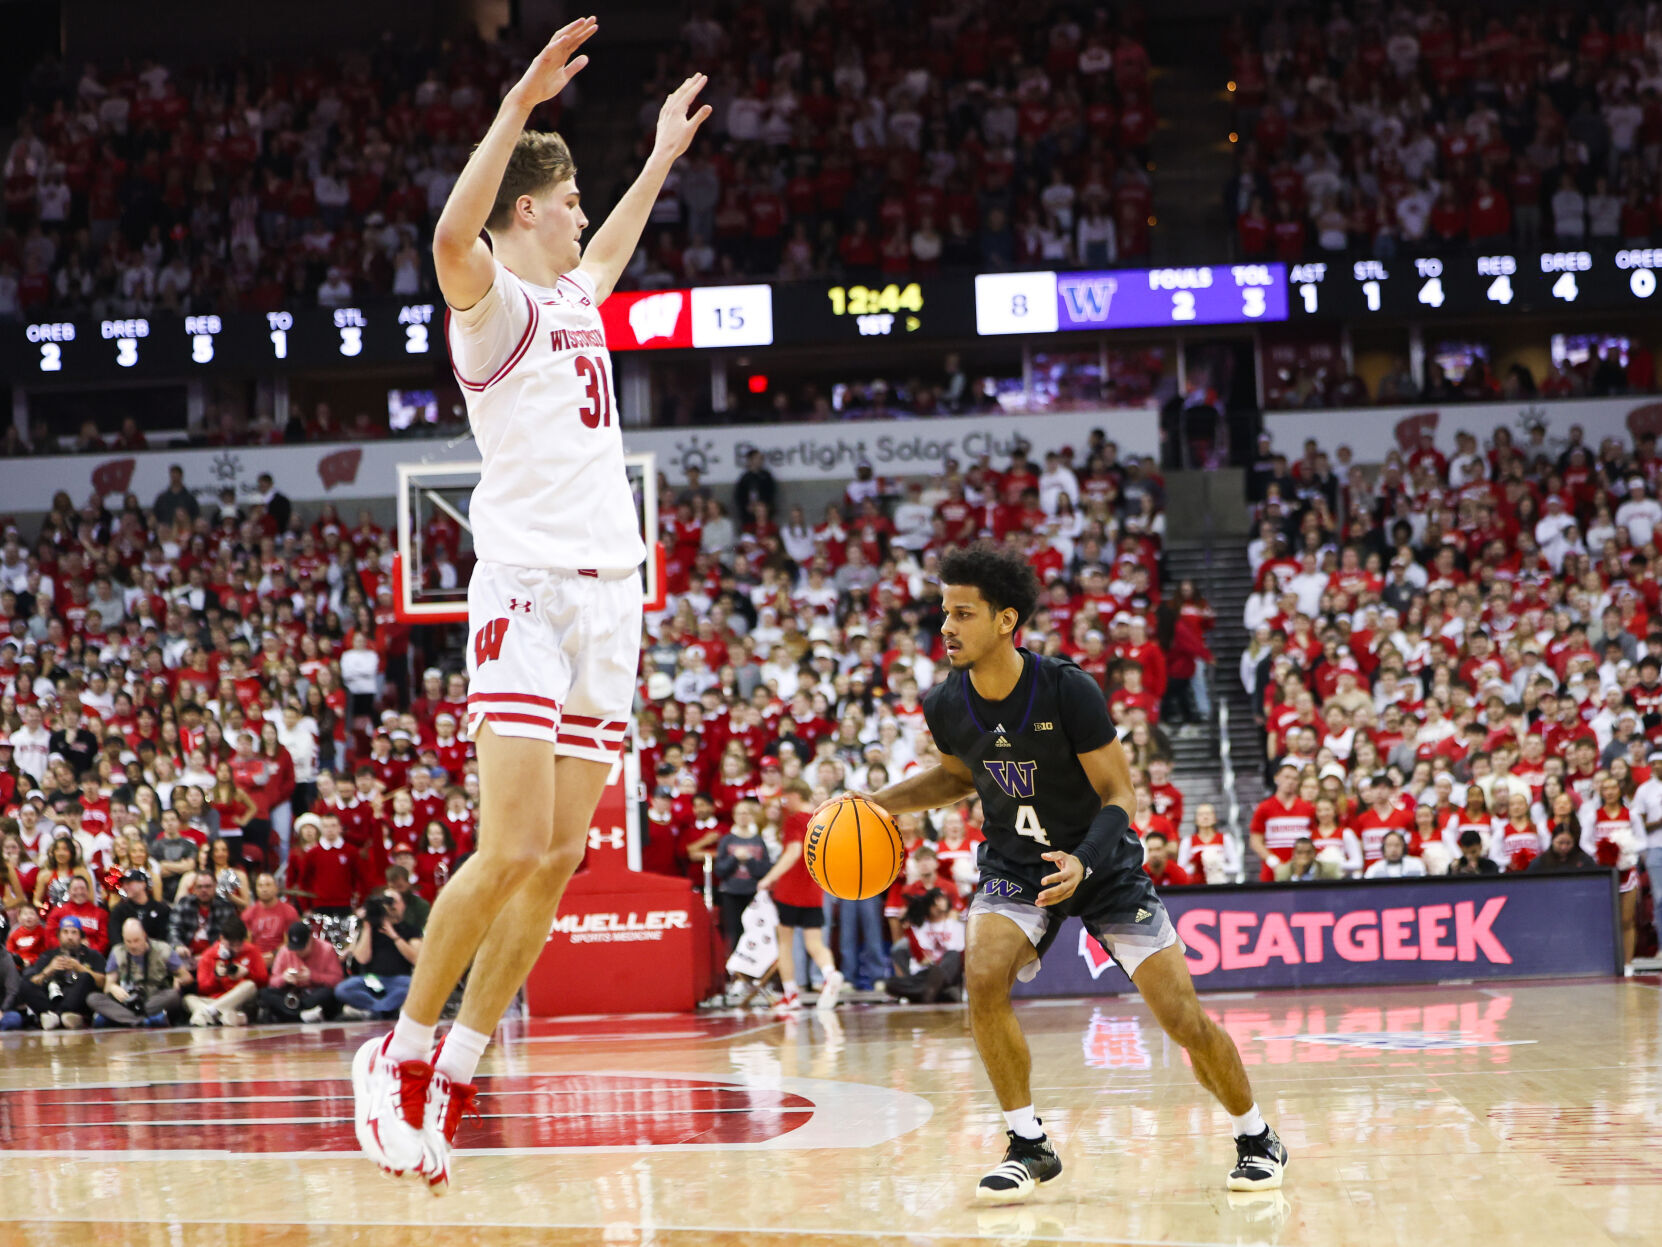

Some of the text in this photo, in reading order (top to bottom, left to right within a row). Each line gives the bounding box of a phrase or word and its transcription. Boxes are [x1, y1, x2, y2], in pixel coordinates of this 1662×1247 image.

[1231, 264, 1274, 286] TOL
[1290, 263, 1327, 283] AST
[1353, 261, 1389, 280] STL
[1414, 258, 1443, 278] TO
[1477, 256, 1517, 275] REB
[1541, 252, 1592, 272] DREB
[1149, 267, 1213, 290] FOULS
[1418, 277, 1445, 307] 4
[1487, 275, 1514, 304] 4
[1552, 272, 1579, 302] 4
[1630, 269, 1657, 298] 0
[828, 283, 924, 316] 12:44
[1011, 295, 1028, 317] 8
[1058, 277, 1118, 322] W
[1171, 290, 1196, 320] 2
[1241, 287, 1266, 317] 3
[1300, 283, 1318, 313] 1
[1363, 281, 1381, 311] 1
[185, 315, 222, 335] REB
[266, 311, 294, 330] TO
[333, 308, 368, 327] STL
[398, 304, 434, 324] AST
[713, 306, 745, 330] 15
[26, 323, 76, 342] OREB
[101, 318, 150, 339] DREB
[339, 326, 363, 356] 3
[405, 324, 429, 353] 2
[40, 343, 62, 371] 2
[116, 338, 138, 367] 3
[270, 330, 287, 358] 1
[574, 355, 610, 428] 31
[475, 617, 510, 671] W
[983, 760, 1038, 798] W
[1015, 805, 1051, 846] 4
[984, 879, 1023, 898] W
[549, 910, 689, 933] MUELLER
[1176, 896, 1513, 975] SEATGEEK
[570, 930, 663, 944] SPORTS MEDICINE
